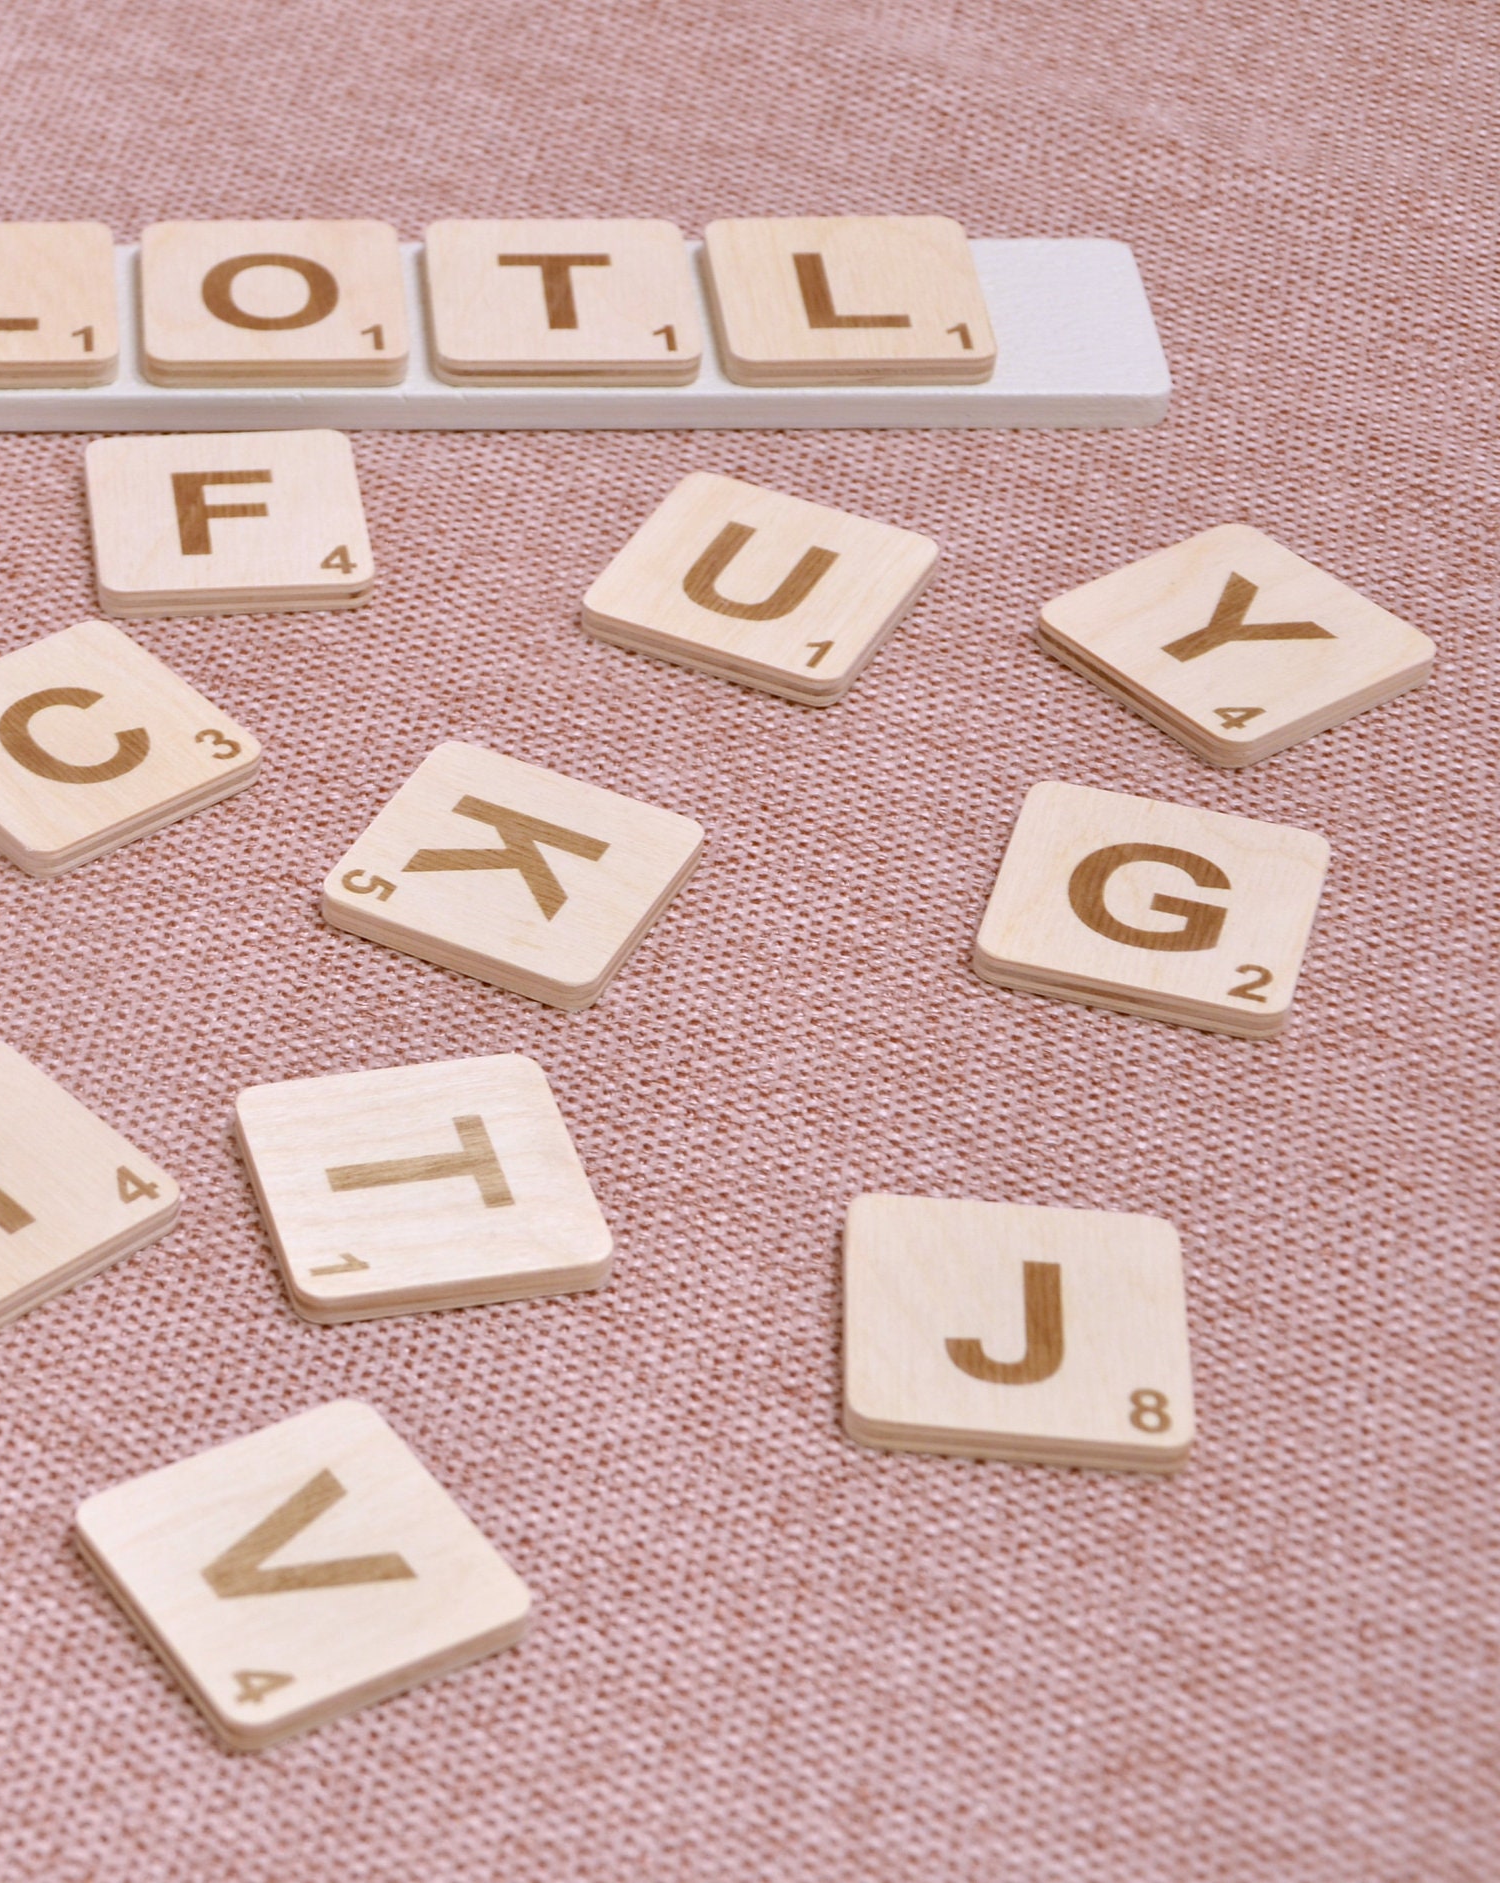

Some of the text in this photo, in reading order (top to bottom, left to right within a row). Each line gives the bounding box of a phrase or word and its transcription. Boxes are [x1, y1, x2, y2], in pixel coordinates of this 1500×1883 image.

[202, 254, 339, 331] O
[498, 254, 610, 329] T
[793, 253, 911, 328] L
[72, 326, 94, 352] 1
[362, 325, 388, 351] 1
[653, 325, 677, 351] 1
[948, 323, 974, 349] 1
[171, 470, 272, 555] F
[321, 545, 357, 574] 4
[683, 522, 839, 621] U
[1161, 572, 1337, 662] Y
[806, 641, 834, 668] 1
[1212, 707, 1266, 729] 4
[195, 729, 241, 759] 3
[401, 795, 610, 921] K
[342, 869, 397, 901] 5
[1068, 843, 1231, 952] G
[1228, 965, 1272, 1003] 2
[325, 1115, 515, 1208] T
[117, 1166, 159, 1204] 4
[310, 1253, 370, 1276] 1
[945, 1261, 1064, 1385] J
[1129, 1389, 1171, 1433] 8
[202, 1468, 417, 1599] V
[234, 1670, 295, 1703] 4
